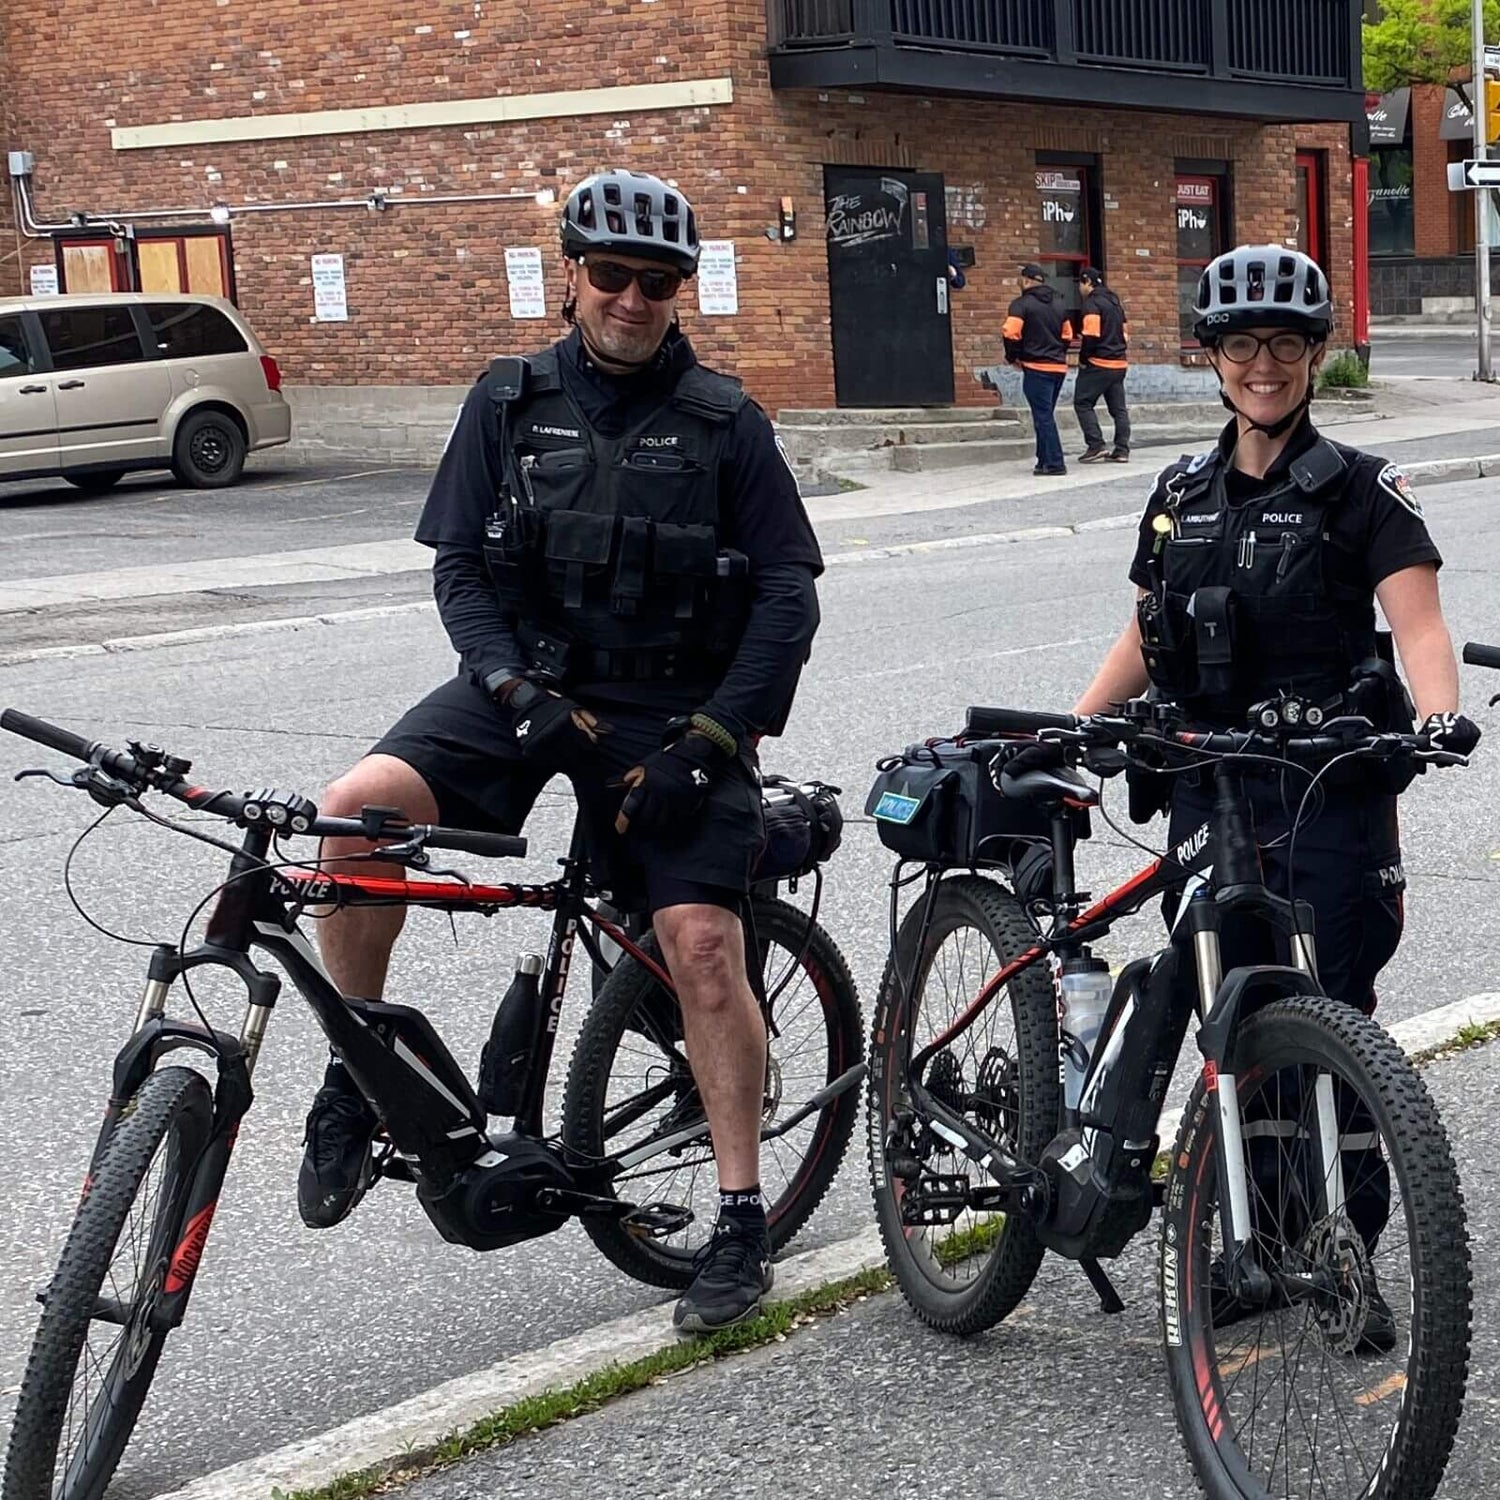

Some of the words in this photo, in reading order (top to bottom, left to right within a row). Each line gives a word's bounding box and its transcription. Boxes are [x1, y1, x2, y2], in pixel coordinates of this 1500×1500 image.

[1177, 184, 1194, 196] JUST
[1194, 184, 1210, 196] EAT
[828, 193, 862, 211] THE
[826, 207, 902, 236] RAINBOW
[639, 437, 679, 447] POLICE
[1262, 512, 1303, 524] POLICE
[1176, 821, 1210, 867] POLICE
[546, 918, 577, 1033] POLICE
[1163, 1243, 1182, 1346] REKON
